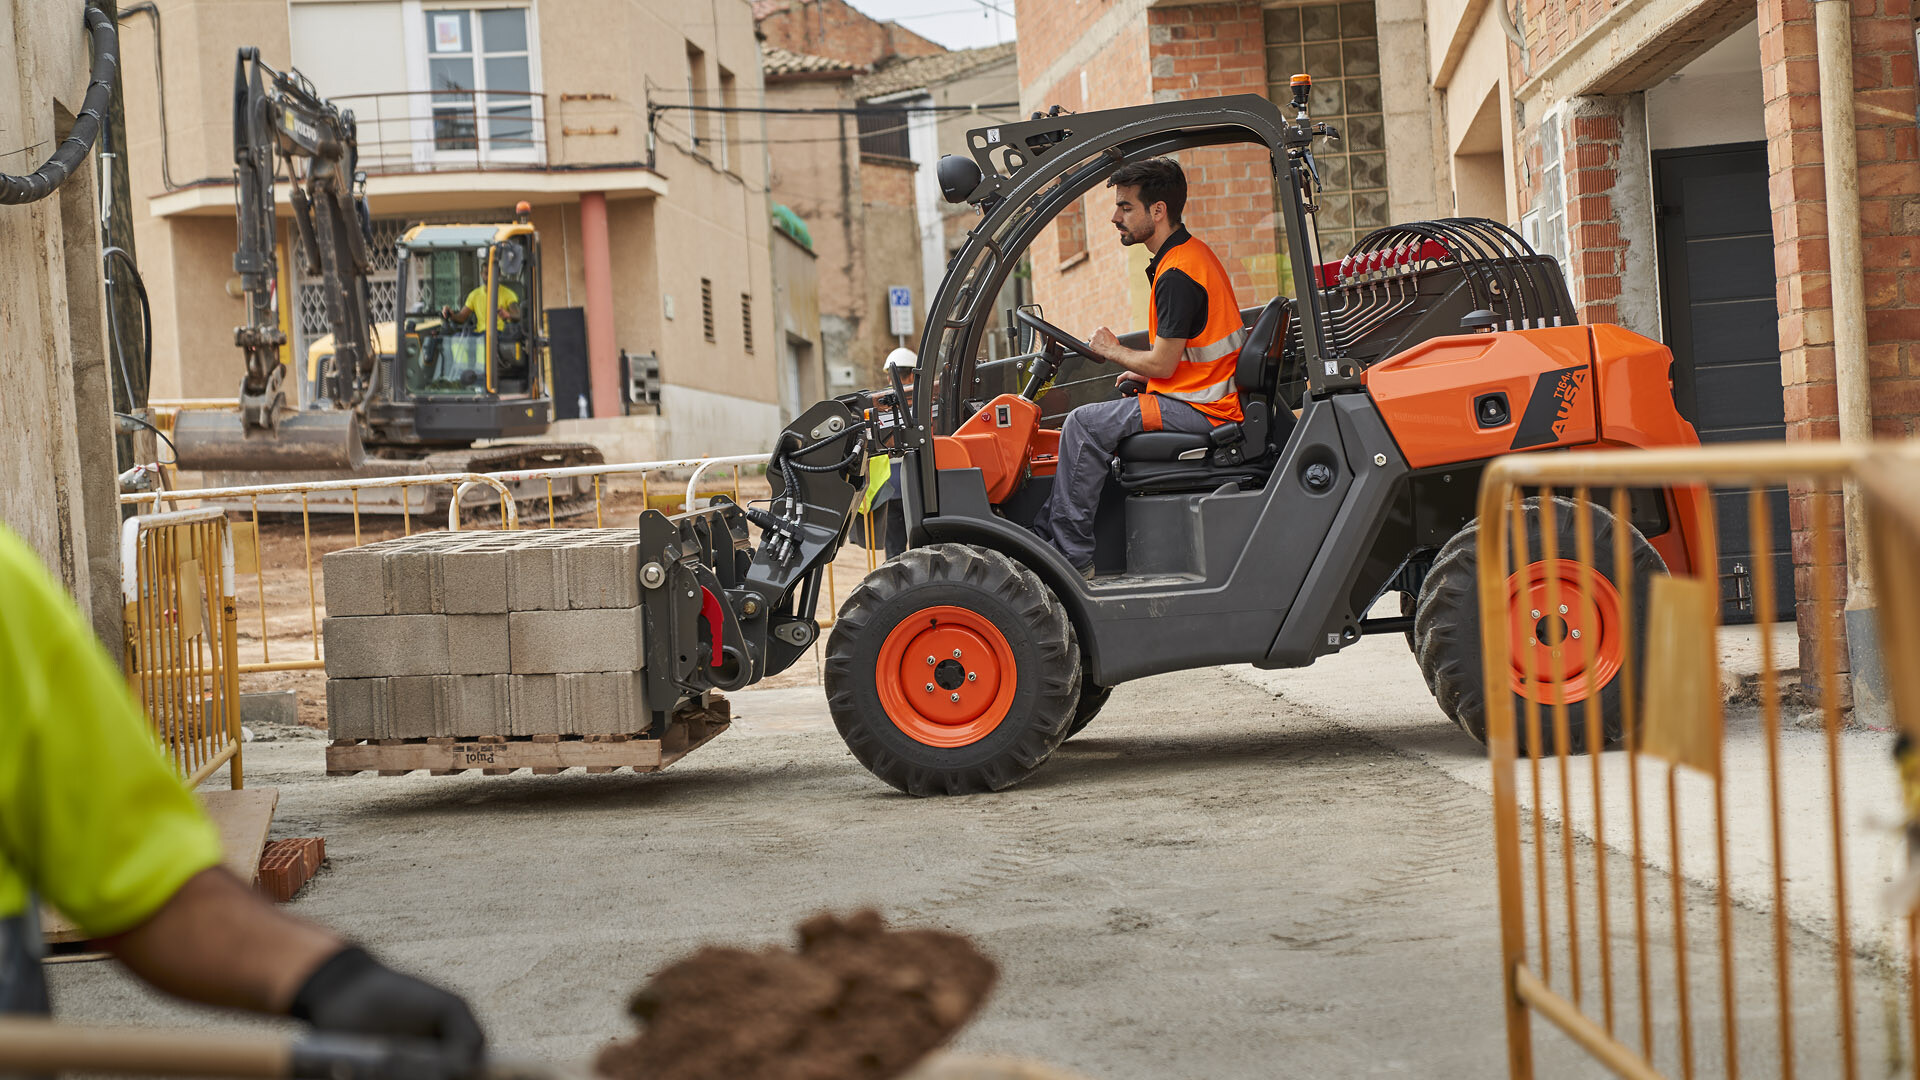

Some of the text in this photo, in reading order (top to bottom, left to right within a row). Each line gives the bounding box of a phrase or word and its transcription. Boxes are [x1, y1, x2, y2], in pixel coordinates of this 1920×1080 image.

[294, 118, 317, 141] VOLVO
[1551, 368, 1588, 440] AUSA
[466, 752, 495, 764] Pujol
